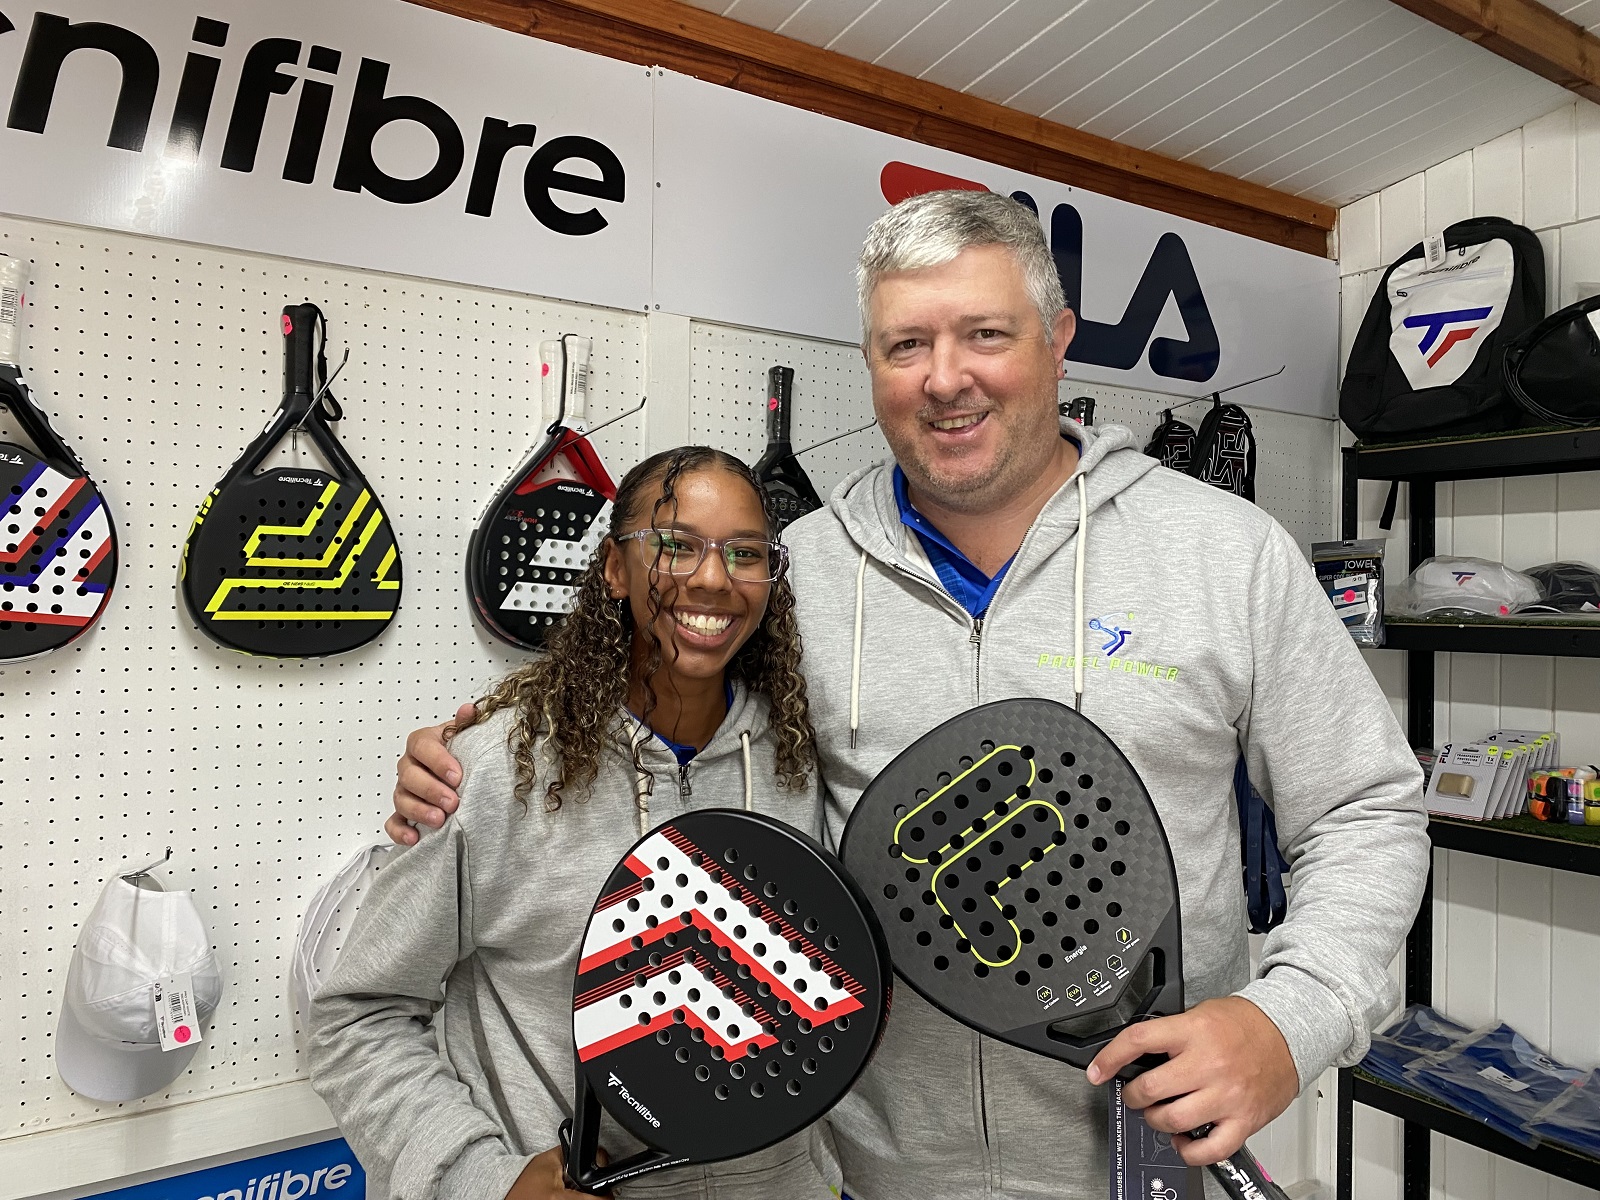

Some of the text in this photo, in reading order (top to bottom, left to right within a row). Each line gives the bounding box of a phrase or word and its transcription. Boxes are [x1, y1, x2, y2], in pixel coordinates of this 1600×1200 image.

[0, 10, 625, 236] nifibre
[1344, 559, 1374, 570] TOWEL
[1109, 656, 1179, 682] POWER
[1438, 743, 1453, 764] FILA
[1089, 972, 1100, 983] AST
[1039, 989, 1051, 1000] 12K
[1068, 987, 1080, 998] EVA
[618, 1085, 661, 1129] Tecnifibre
